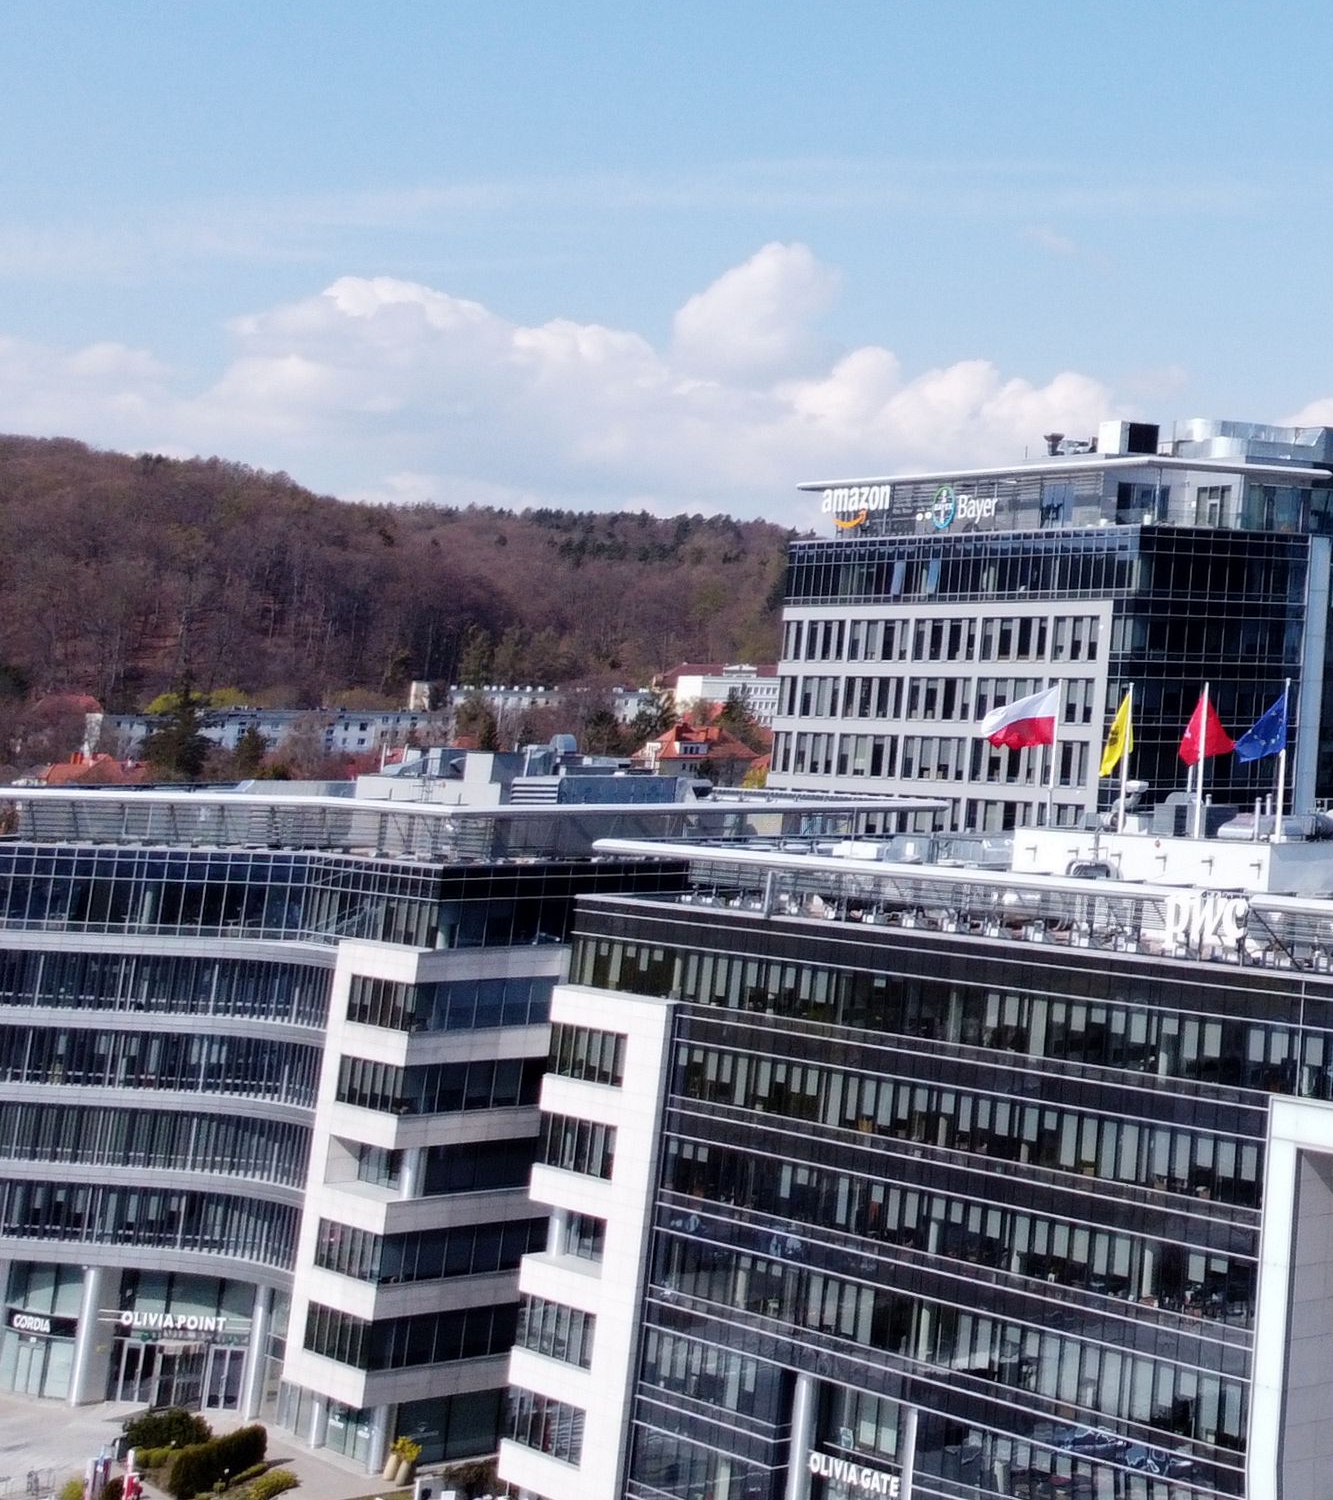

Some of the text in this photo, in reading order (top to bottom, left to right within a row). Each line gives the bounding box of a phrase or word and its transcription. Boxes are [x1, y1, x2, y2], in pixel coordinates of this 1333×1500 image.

[822, 484, 891, 513] amazon
[957, 494, 998, 524] Bayer
[1164, 895, 1249, 956] pwc
[12, 1313, 51, 1333] CORDIA
[120, 1310, 228, 1332] OLIVIA POINT
[809, 1452, 901, 1497] OLIVIA GATE
